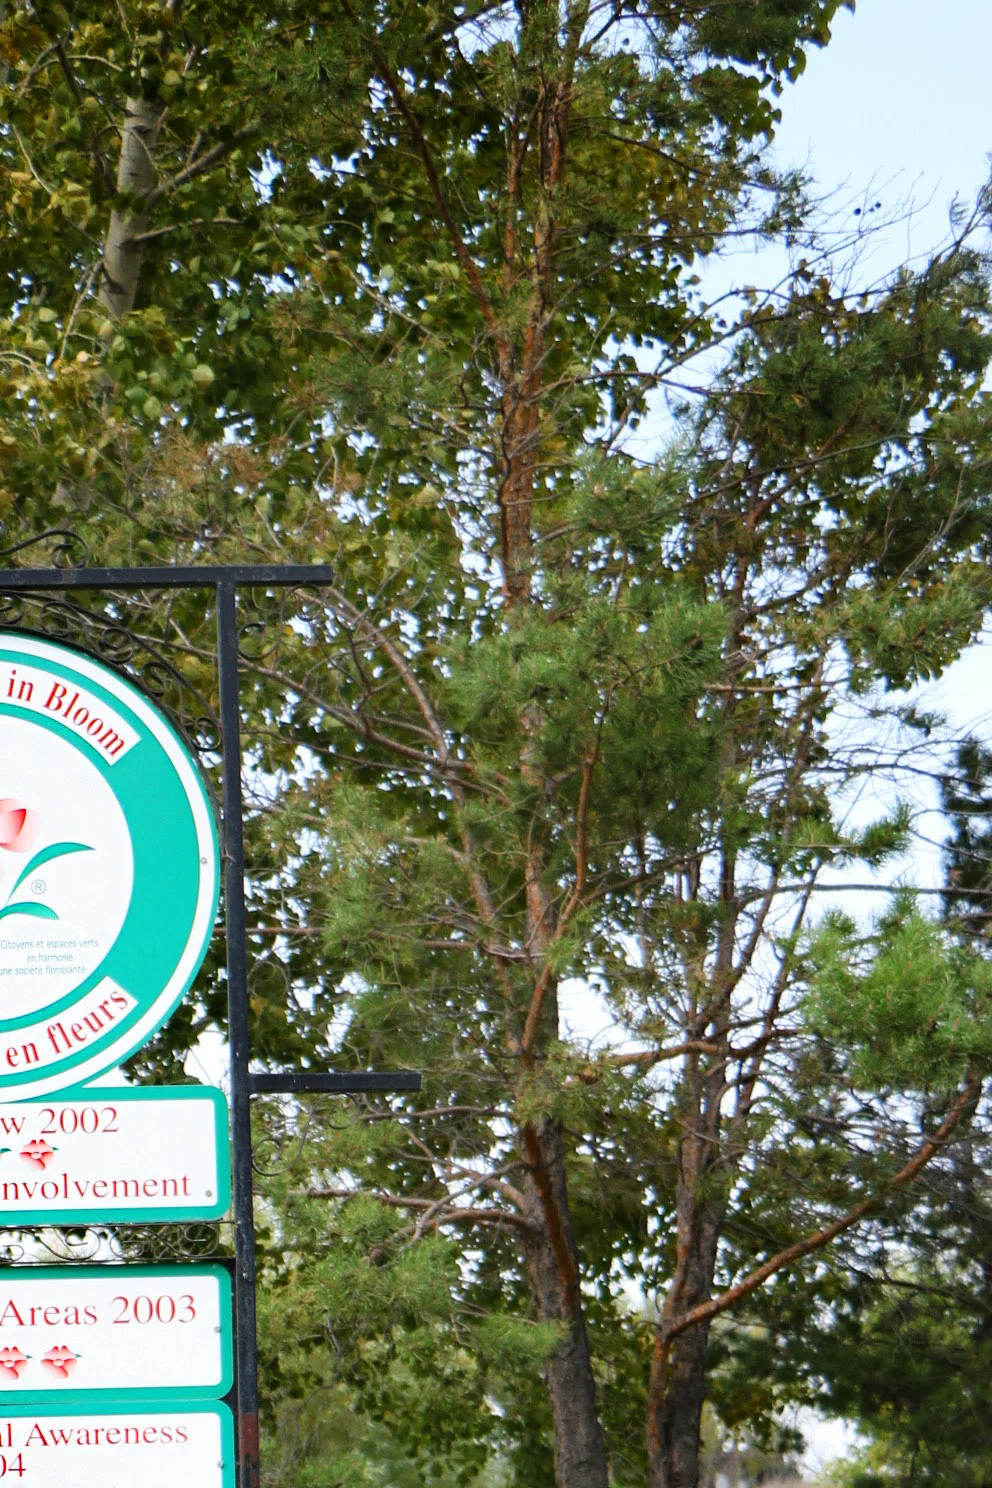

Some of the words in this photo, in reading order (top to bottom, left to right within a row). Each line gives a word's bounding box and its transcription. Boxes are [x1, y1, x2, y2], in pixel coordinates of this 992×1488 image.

[8, 670, 34, 701] in
[43, 680, 127, 757] Bloom
[0, 939, 34, 950] Citoyens
[36, 939, 44, 948] et
[46, 939, 77, 949] espaces
[79, 938, 99, 948] verts
[14, 964, 43, 975] société
[38, 952, 73, 962] harmonie
[6, 1042, 41, 1068] en
[47, 990, 128, 1055] fleurs
[39, 1107, 119, 1134] 2002
[111, 1294, 197, 1324] 2003
[26, 1423, 188, 1446] Awareness
